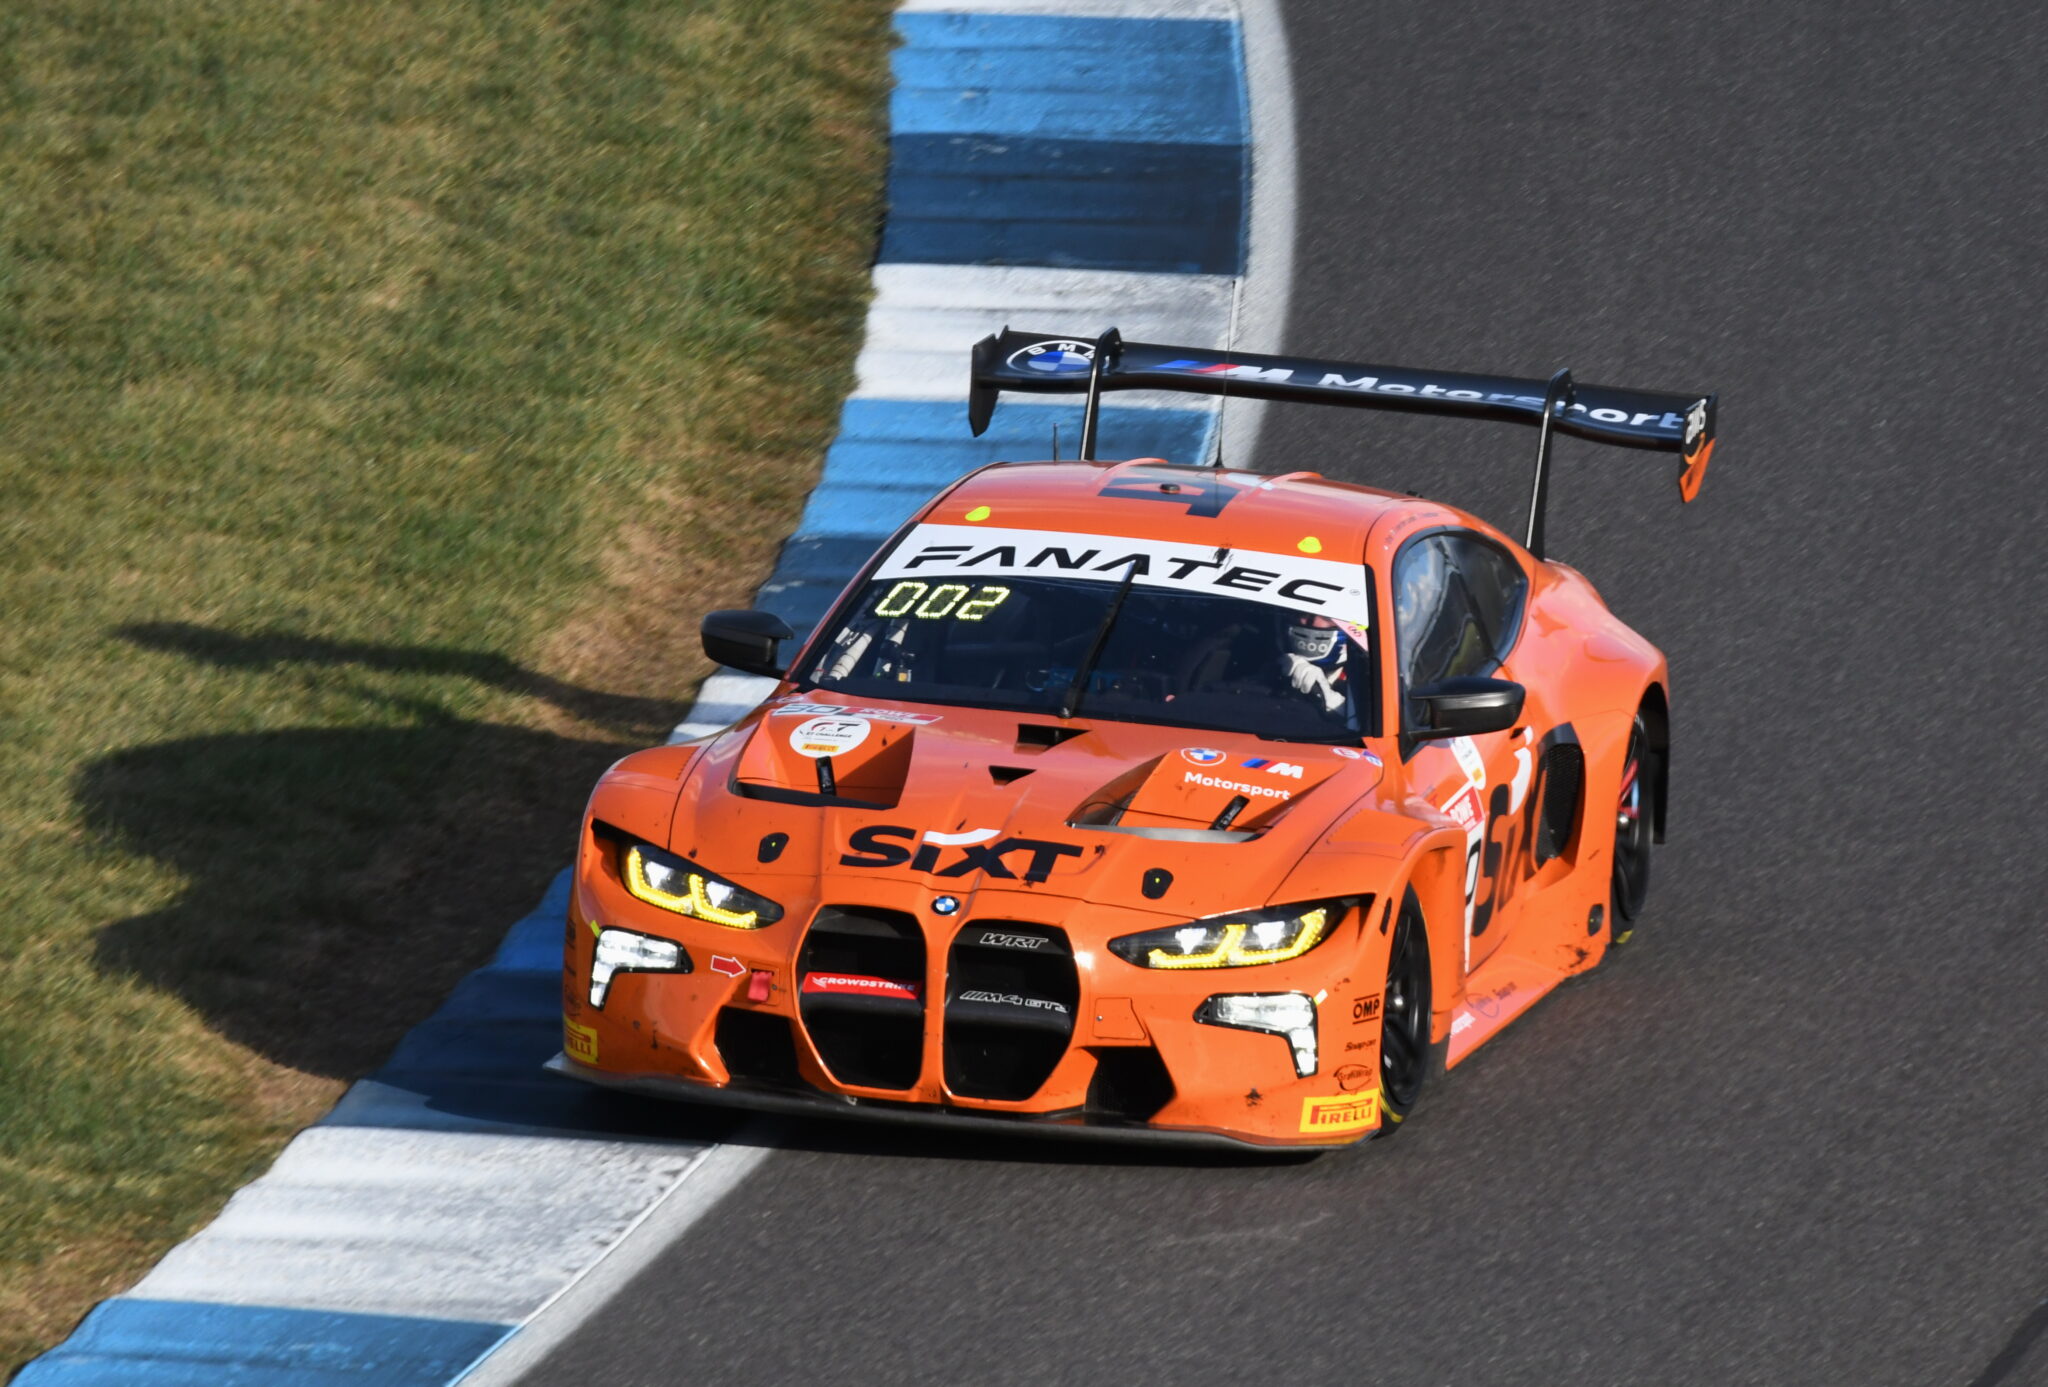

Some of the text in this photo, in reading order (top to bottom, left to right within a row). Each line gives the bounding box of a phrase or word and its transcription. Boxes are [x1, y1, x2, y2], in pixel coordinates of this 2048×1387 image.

[903, 545, 1345, 606] FANATEC
[874, 581, 1010, 620] 002
[1184, 771, 1291, 800] Motorsport
[839, 825, 1084, 883] SIXT
[979, 932, 1049, 948] WRT
[820, 977, 915, 991] CROWDSTRIKE
[1353, 998, 1380, 1019] OMP
[1310, 1098, 1373, 1125] PIRELLI
